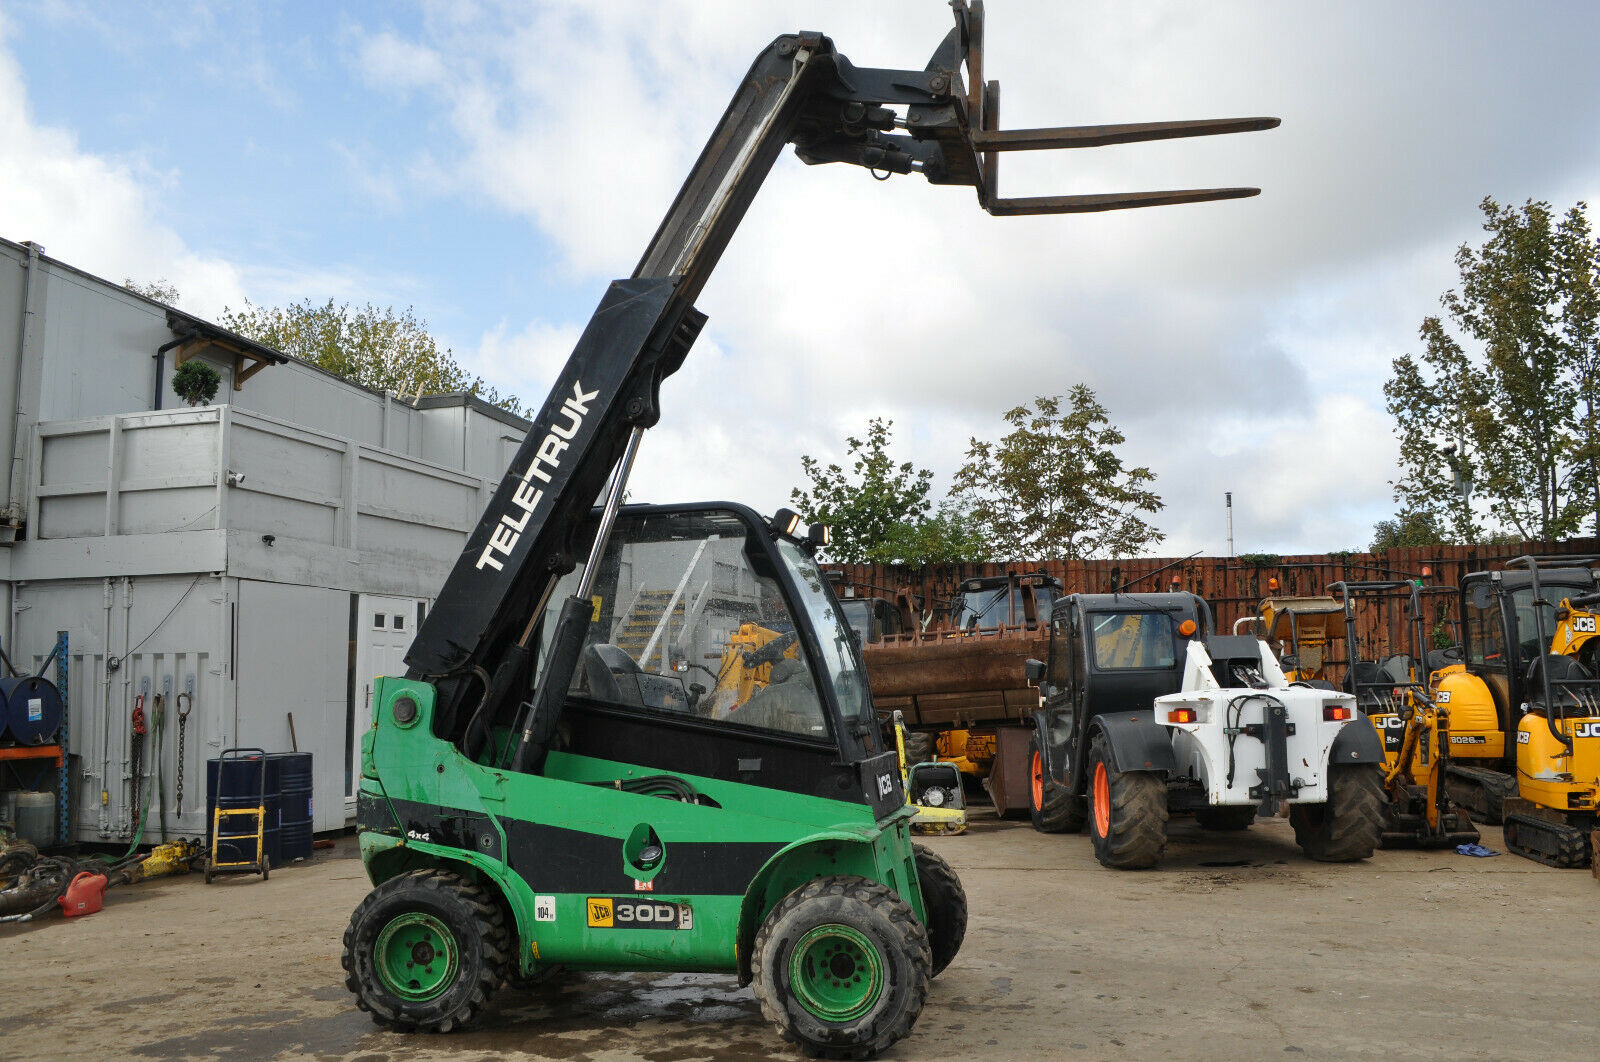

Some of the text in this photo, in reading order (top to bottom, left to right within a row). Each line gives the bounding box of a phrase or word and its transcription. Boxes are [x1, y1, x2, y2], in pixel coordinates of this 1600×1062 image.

[475, 379, 600, 572] TELETRUK
[1573, 617, 1596, 632] JCB
[1435, 691, 1451, 703] CB
[876, 773, 893, 801] JCB
[407, 829, 430, 841] 4x4
[537, 906, 549, 919] 104
[593, 904, 675, 922] JCB 30D
